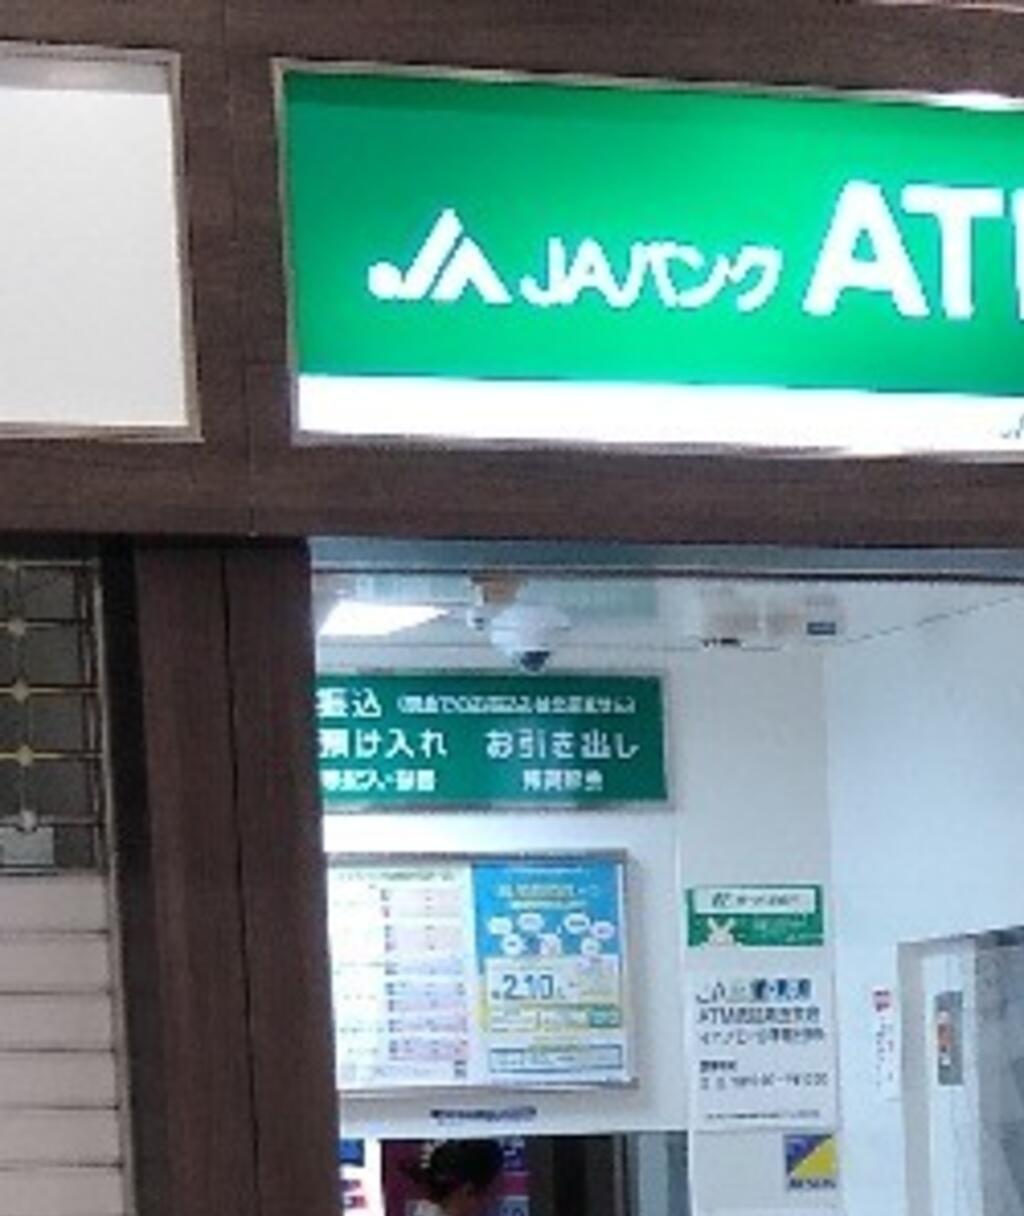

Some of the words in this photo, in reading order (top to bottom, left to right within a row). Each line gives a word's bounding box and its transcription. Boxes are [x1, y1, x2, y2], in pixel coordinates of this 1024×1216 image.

[485, 728, 640, 760] お引き出し
